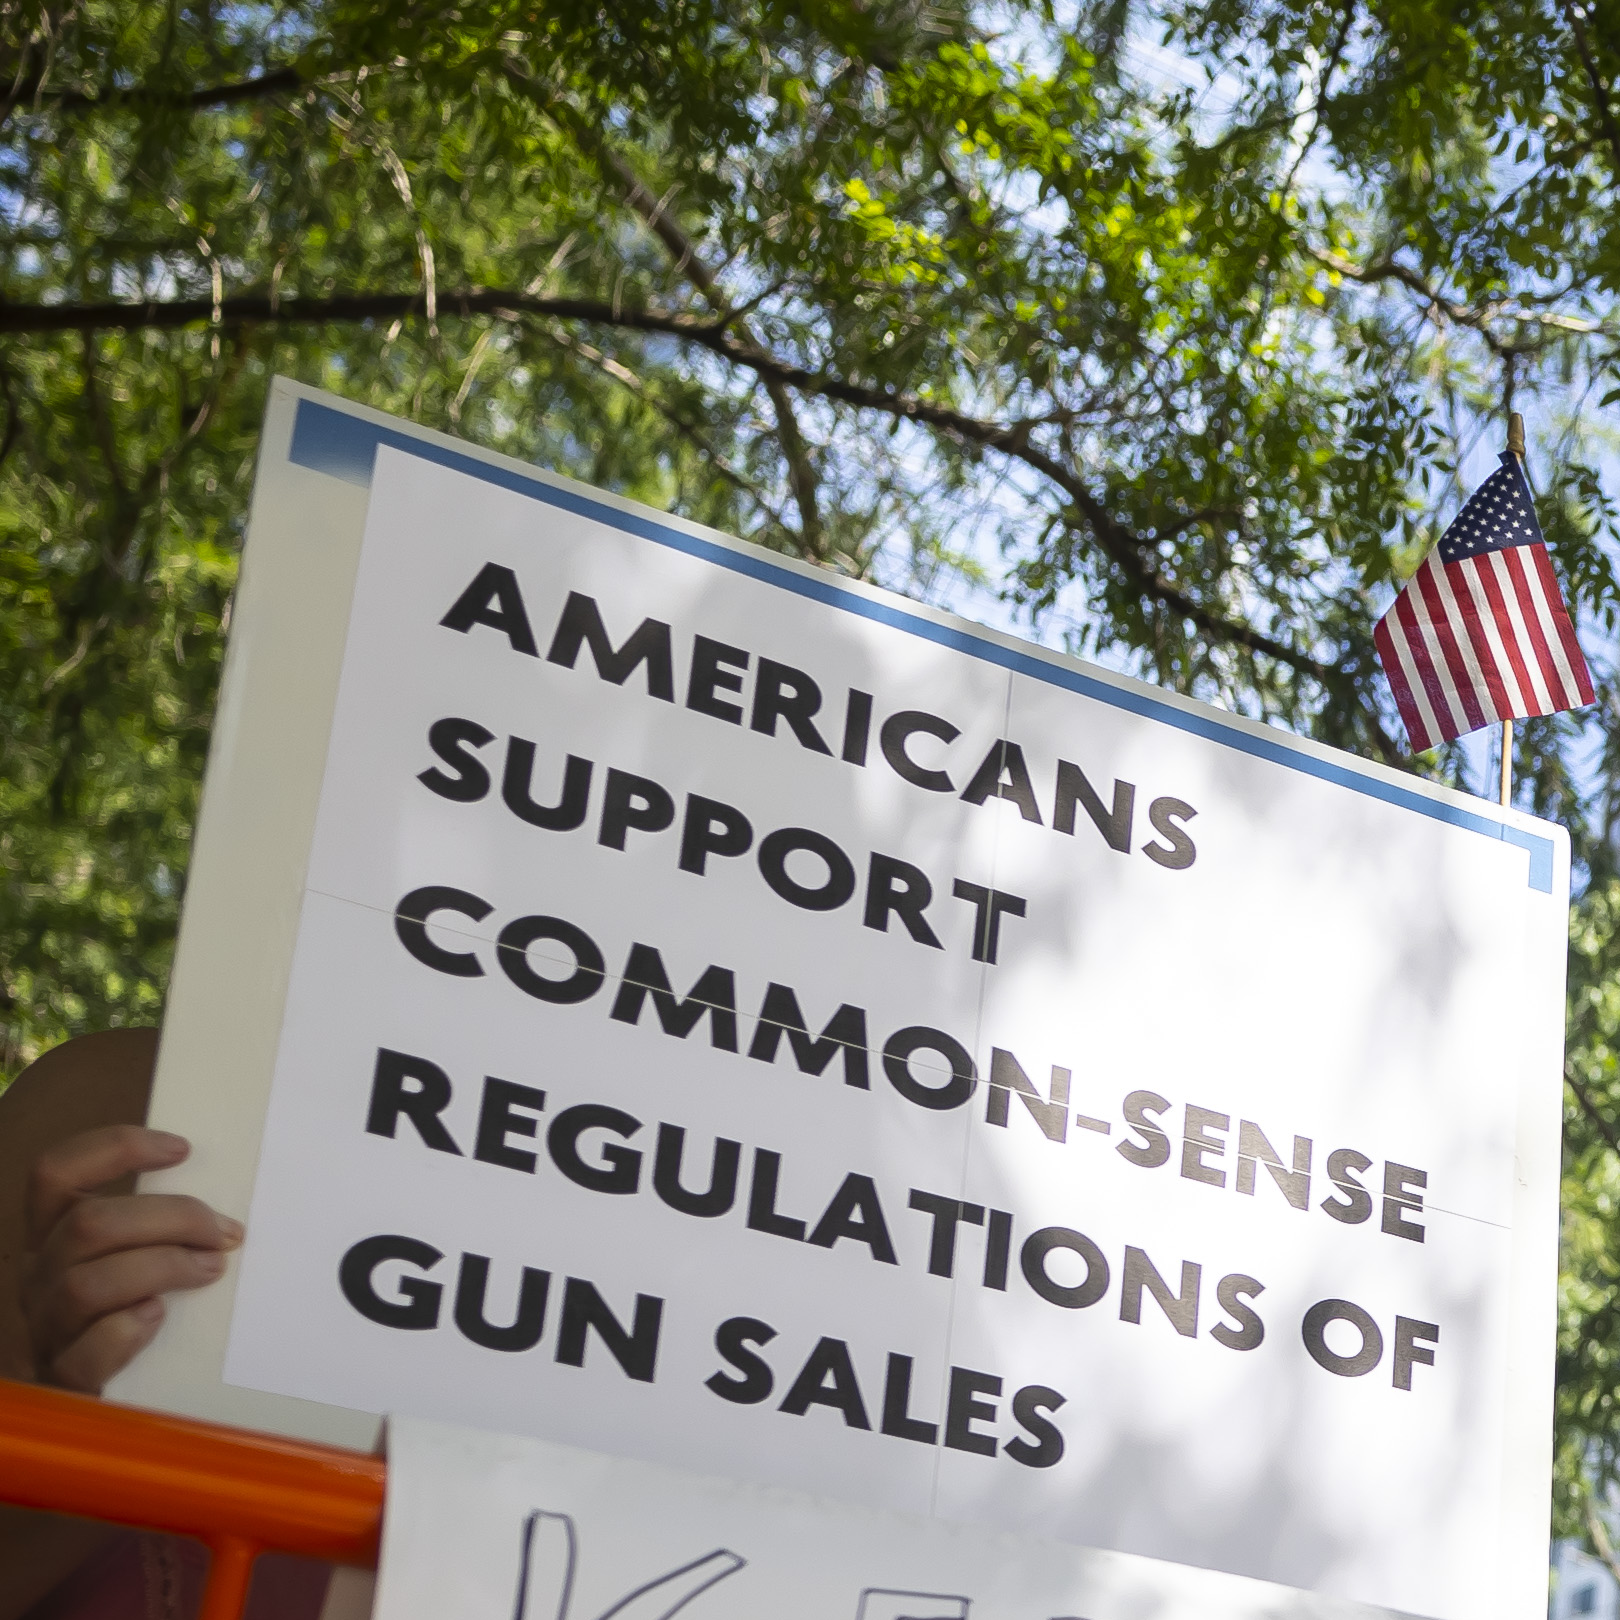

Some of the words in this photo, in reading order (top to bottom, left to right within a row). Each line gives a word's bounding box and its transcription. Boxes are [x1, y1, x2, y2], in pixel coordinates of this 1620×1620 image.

[416, 718, 1028, 968] SUPPORT
[438, 560, 1200, 872] AMERICANS
[364, 1045, 1268, 1354] REGULATIONS
[1300, 1298, 1441, 1394] OF
[392, 885, 1429, 1245] COMMON-SENSE
[338, 1232, 665, 1385] GUN
[705, 1315, 1068, 1470] SALES
